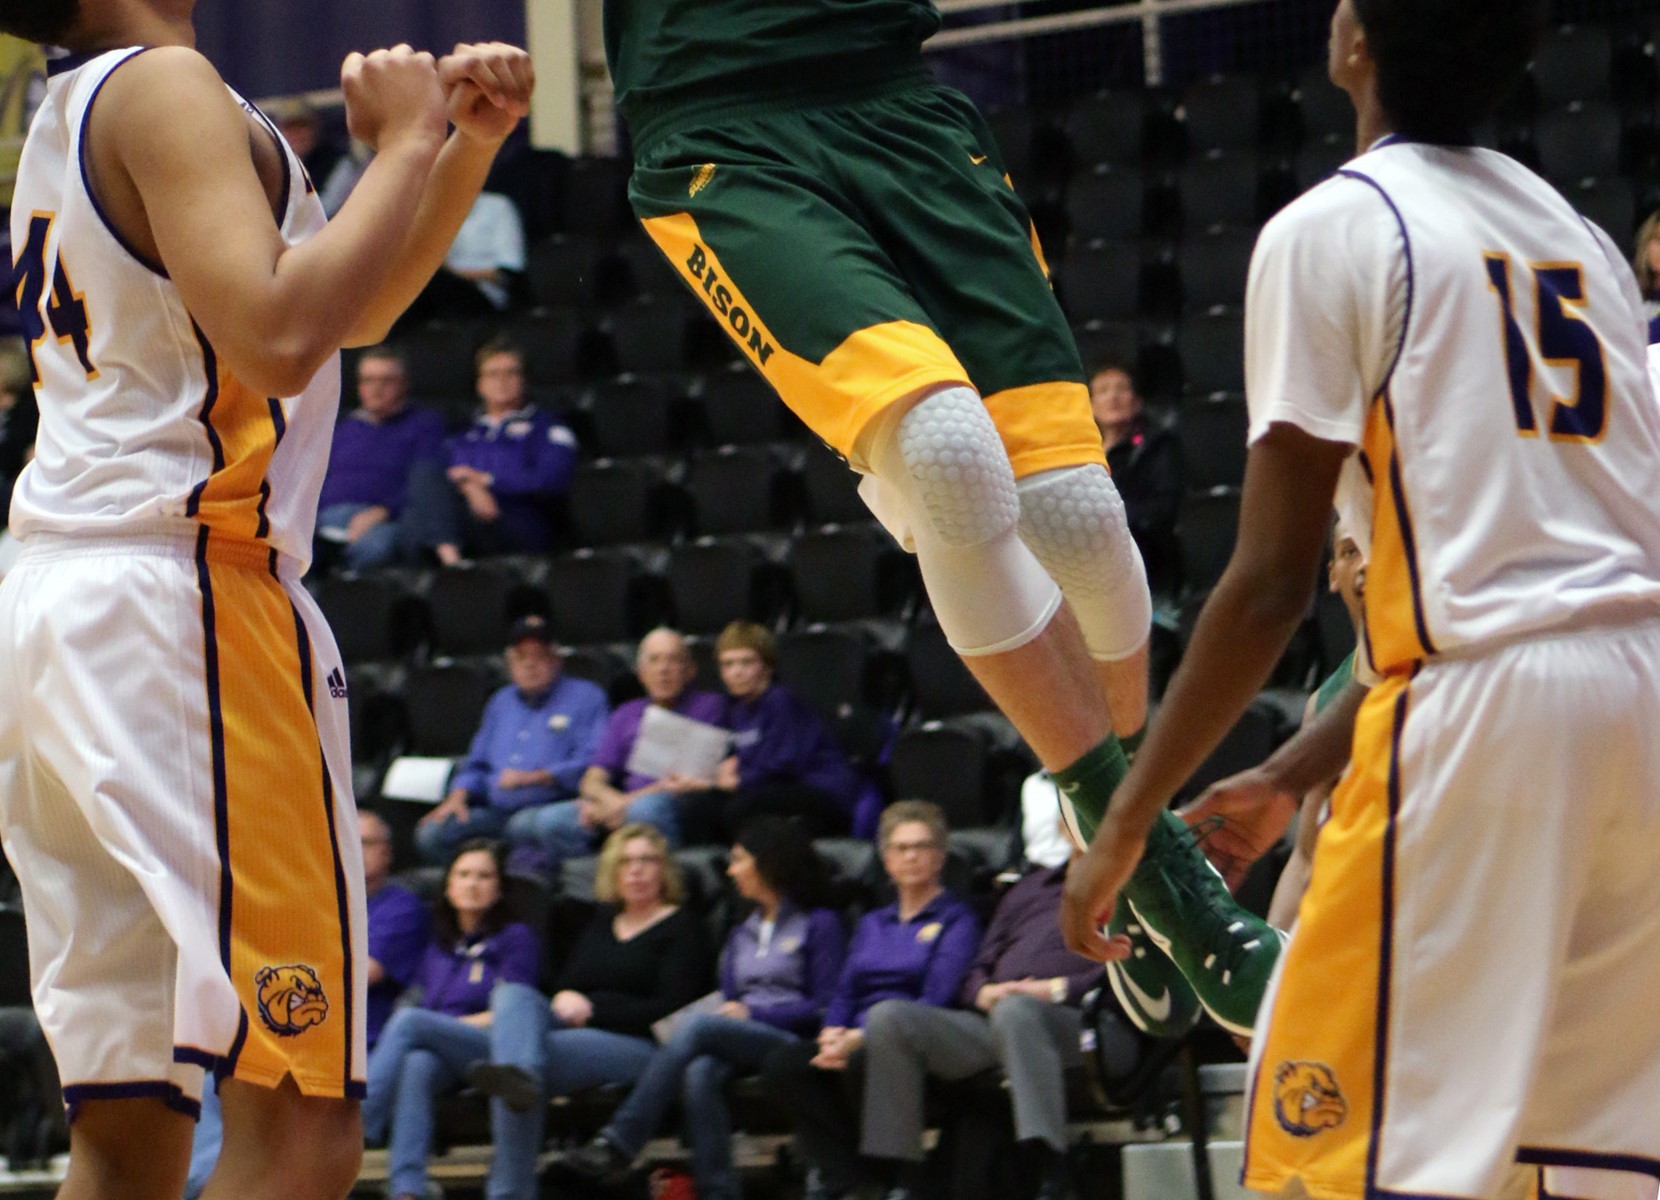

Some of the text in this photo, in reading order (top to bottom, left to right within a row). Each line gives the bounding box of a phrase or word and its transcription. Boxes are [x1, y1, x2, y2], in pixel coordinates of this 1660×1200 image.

[13, 209, 101, 390] 44
[687, 243, 775, 366] BISON
[1481, 250, 1612, 445] 15
